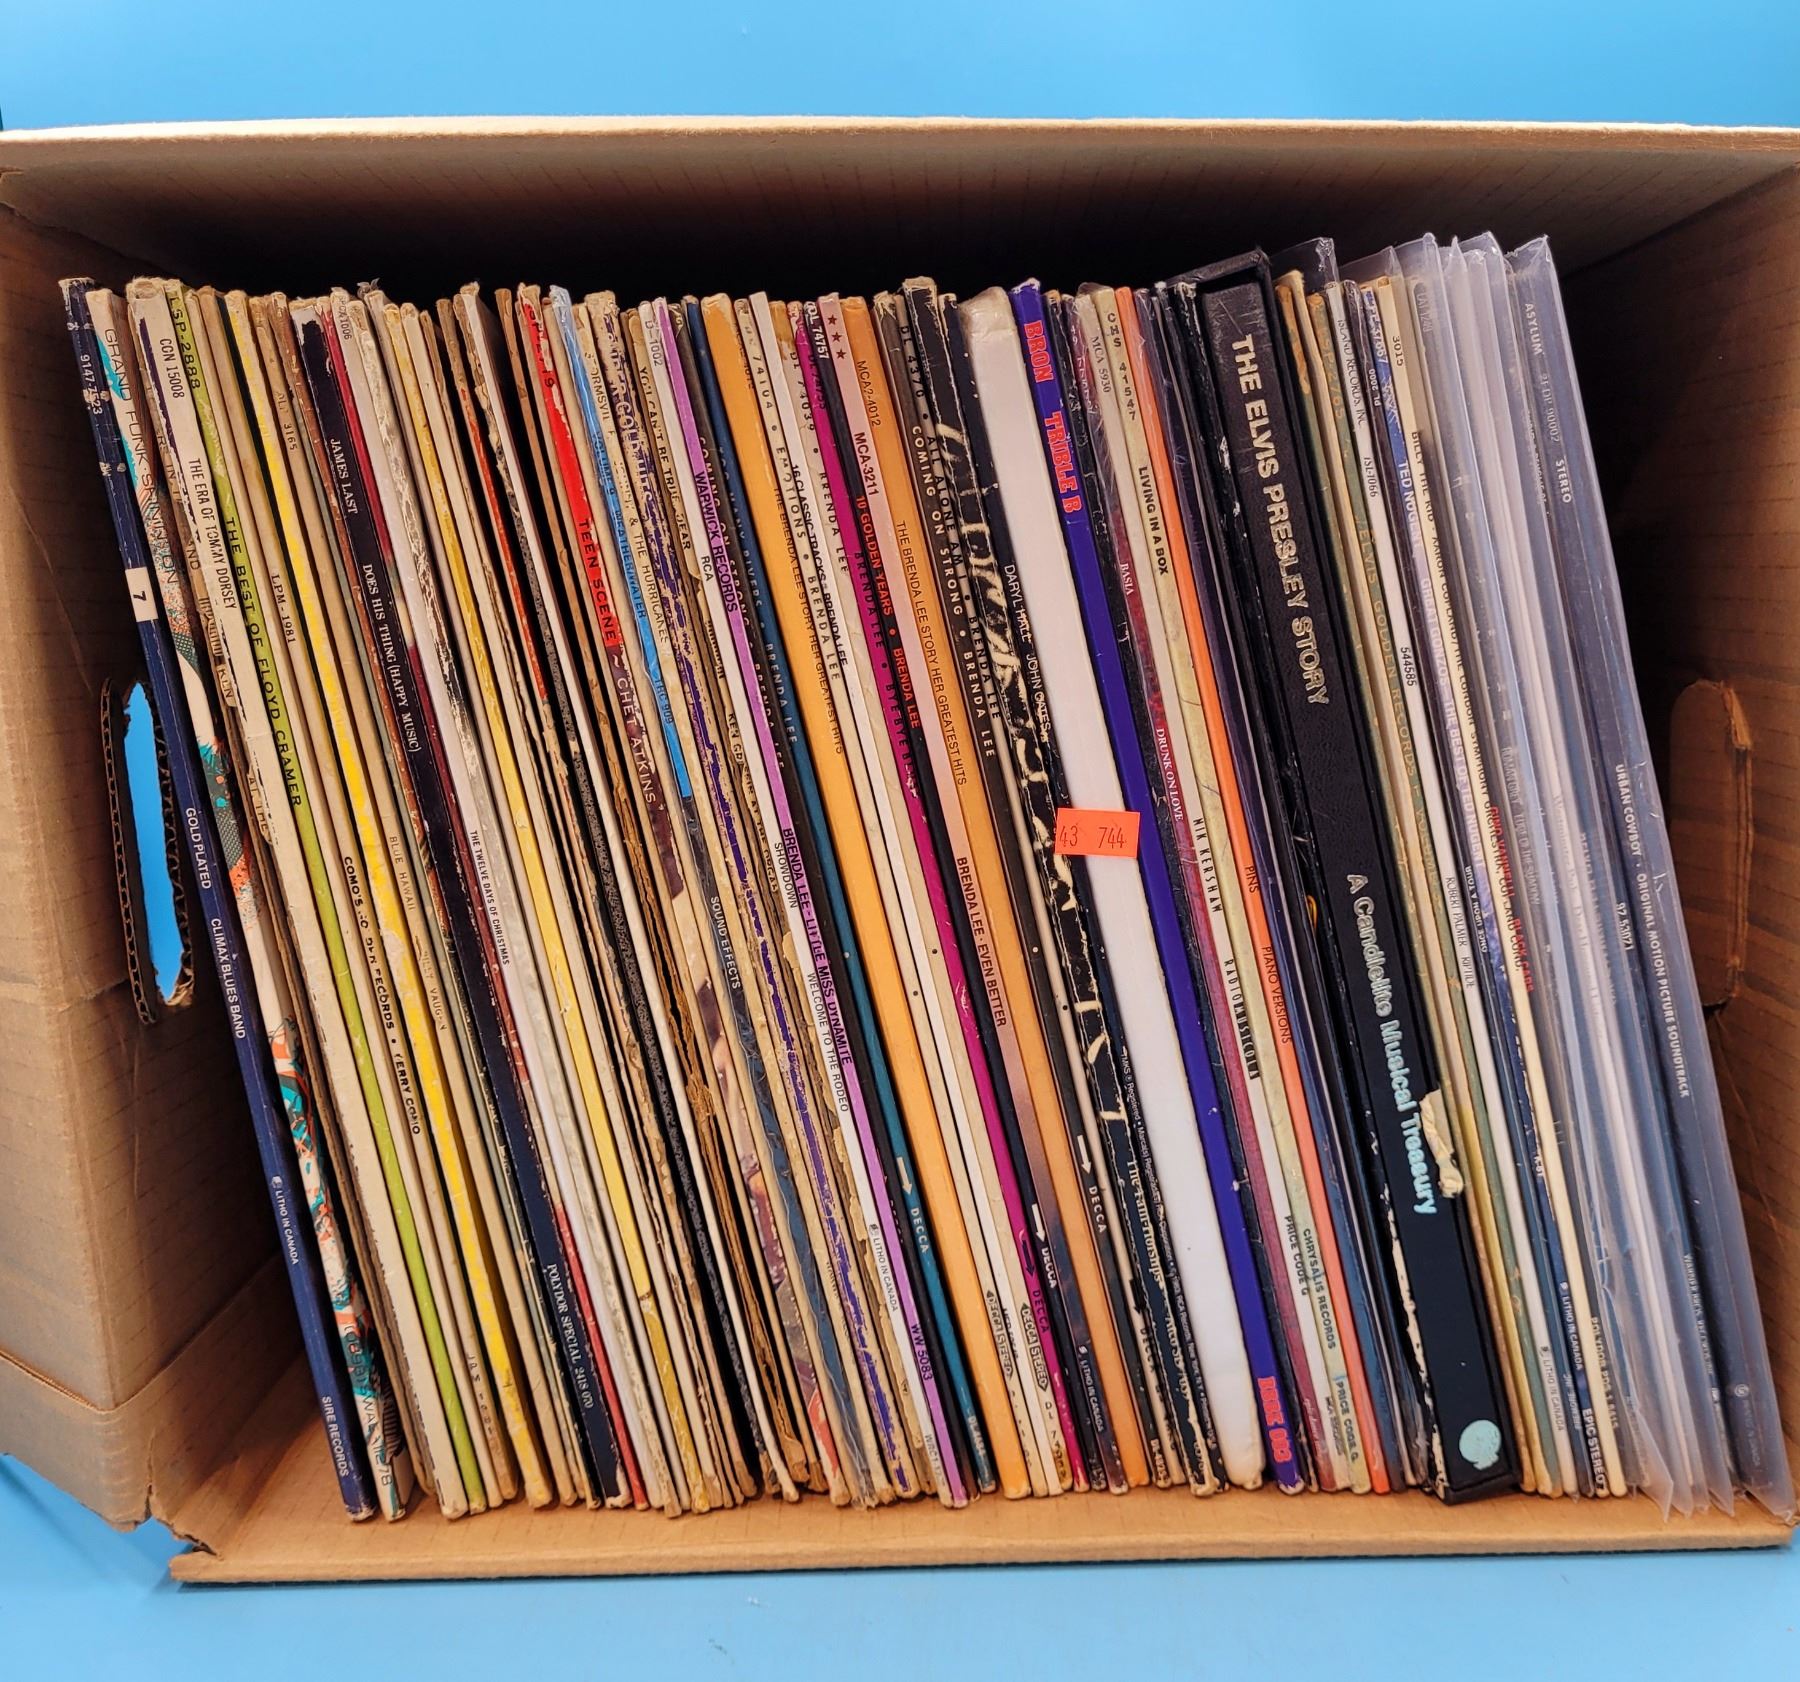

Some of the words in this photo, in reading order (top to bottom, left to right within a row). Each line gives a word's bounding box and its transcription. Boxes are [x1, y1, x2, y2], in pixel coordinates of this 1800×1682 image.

[811, 325, 829, 361] 74757
[1021, 319, 1055, 385] BRON
[1089, 334, 1106, 364] MCA
[1390, 334, 1406, 367] 3015
[164, 365, 185, 399] 15008
[905, 353, 926, 399] 4370
[1097, 366, 1112, 394] 5930
[1228, 332, 1264, 395] THE
[103, 326, 133, 403] GRAND
[123, 409, 149, 466] FUNK
[1522, 301, 1544, 357] ASYLUM
[1553, 457, 1573, 505] STEREO
[924, 433, 942, 466] ALL
[1243, 397, 1282, 479] ELVIS
[187, 457, 204, 482] THE
[328, 436, 350, 480] JAMES
[852, 430, 880, 496] MCA-3211
[1395, 459, 1413, 489] TED
[193, 481, 210, 505] ERA
[340, 481, 359, 515] LAST
[854, 494, 868, 511] 10
[932, 473, 957, 533] ALONE
[1061, 494, 1083, 515] B
[1136, 465, 1157, 514] LIVING
[199, 505, 215, 522] OF
[1147, 515, 1161, 533] IN
[223, 516, 242, 555] THE
[632, 533, 648, 558] THE
[693, 470, 722, 541] WARWICK
[711, 544, 739, 614] RECORDS
[858, 511, 882, 569] GOLDEN
[894, 520, 911, 548] THE
[948, 539, 966, 567] AM
[1260, 481, 1310, 612] PRESLEY
[360, 562, 380, 595] DOES
[576, 519, 600, 569] TEEN
[590, 576, 618, 642] SCENE
[699, 554, 715, 582] RCA
[900, 546, 923, 600] BRENDA
[1118, 561, 1135, 596] BASIA
[1153, 547, 1170, 576] BOX
[214, 566, 237, 611] DORSEY
[234, 564, 255, 613] BEST
[873, 571, 894, 617] YEARS
[909, 424, 937, 498] COMING
[929, 509, 945, 535] ON
[937, 546, 964, 616] STRONG
[961, 650, 987, 719] BRENDA
[979, 729, 996, 758] LEE
[1002, 563, 1024, 607] DARYL
[369, 596, 387, 621] HIS
[913, 598, 929, 624] LEE
[247, 621, 264, 649] OF
[376, 622, 398, 664] THING
[919, 624, 940, 667] STORY
[967, 615, 993, 684] BRENDA
[1356, 527, 1379, 585] ELVIS
[1372, 599, 1399, 679] GOLDEN
[1389, 686, 1419, 777] RECORDS
[891, 646, 915, 702] BRENDA
[929, 666, 946, 693] HER
[1024, 651, 1044, 690] JOHN
[1289, 613, 1331, 709] STORY
[1397, 645, 1417, 688] 544585
[255, 657, 282, 721] FLOYD
[386, 663, 410, 708] (HAPPY
[985, 690, 1002, 720] LEE
[399, 711, 422, 754] MUSIC)
[905, 703, 921, 729] LEE
[935, 692, 961, 757] GREATEST
[614, 677, 637, 726] CHET
[629, 734, 657, 805] ATKINS
[1153, 726, 1173, 771] DRUNK
[273, 729, 303, 807] CRAMER
[951, 757, 968, 786] HITS
[1163, 770, 1177, 790] ON
[1613, 762, 1632, 805] URBAN
[183, 806, 203, 843] GOLD
[1167, 789, 1185, 822] LOVE
[469, 829, 481, 847] THE
[1060, 825, 1078, 848] 43
[1098, 826, 1126, 849] 744
[1190, 817, 1207, 842] NIK
[1621, 805, 1643, 859] COWBOY
[192, 843, 213, 889] PLATED
[473, 848, 490, 881] TWELVE
[780, 827, 804, 881] BRENDA
[481, 882, 495, 904] DAYS
[772, 841, 798, 909] SHOWDOWN
[955, 855, 979, 911] BRENDA
[1198, 847, 1224, 914] KERSHAW
[1242, 864, 1259, 894] PINS
[1345, 870, 1370, 894] A
[1444, 875, 1462, 910] ROBERT
[1463, 864, 1477, 892] TOUR
[488, 905, 499, 917] OF
[795, 883, 811, 910] LEE
[1470, 901, 1484, 928] UPON
[1634, 871, 1657, 930] ORIGINAL
[209, 917, 230, 963] CLIMAX
[490, 917, 511, 965] CHRISTMAS
[708, 895, 728, 937] SOUND
[718, 938, 742, 990] EFFECTS
[969, 911, 985, 937] LEE
[1451, 910, 1470, 947] PALMER
[1476, 928, 1489, 954] ONCE
[976, 942, 995, 978] EVEN
[1260, 944, 1279, 985] PIANO
[1645, 928, 1666, 978] MOTION
[219, 962, 239, 1003] BLUES
[805, 971, 829, 1028] WELCOME
[816, 964, 835, 999] MISS
[1222, 958, 1243, 1003] RADIO
[984, 978, 1008, 1028] BETTER
[1269, 986, 1293, 1045] VERSIONS
[1655, 977, 1675, 1024] PICTURE
[228, 1003, 247, 1039] BAND
[819, 1028, 834, 1047] TO
[825, 999, 853, 1066] DYNAMITE
[824, 1047, 840, 1071] THE
[1377, 1018, 1418, 1113] Musical
[1664, 1023, 1691, 1099] SOUNDTRACK
[830, 1071, 851, 1113] RODEO
[1392, 1110, 1441, 1219] Treasury
[274, 1189, 288, 1217] LITHO
[280, 1217, 291, 1228] IN
[1086, 1184, 1107, 1234] DECCA
[283, 1228, 299, 1265] CANADA
[871, 1236, 885, 1262] LITHO
[908, 1206, 930, 1253] DECCA
[878, 1263, 889, 1275] IN
[1039, 1246, 1058, 1289] DECCA
[881, 1275, 898, 1312] CANADA
[1300, 1227, 1324, 1294] CHRYSALIS
[1315, 1294, 1337, 1350] RECORDS
[545, 1262, 570, 1313] POLYDOR
[559, 1314, 583, 1364] SPECIAL
[1030, 1288, 1050, 1334] DECCA
[1560, 1295, 1574, 1322] LITHO
[1565, 1321, 1576, 1334] IN
[909, 1322, 925, 1348] WW
[1020, 1307, 1038, 1344] DECCA
[1029, 1345, 1049, 1387] STEREO
[1568, 1332, 1584, 1371] CANADA
[915, 1348, 933, 1381] 5083
[1079, 1359, 1093, 1386] LITHO
[320, 1395, 336, 1423] SIRE
[1085, 1385, 1096, 1397] IN
[1334, 1380, 1351, 1416] PRICE
[1088, 1395, 1105, 1433] CANADA
[1549, 1395, 1565, 1433] CANADA
[1580, 1406, 1598, 1438] EPIC
[327, 1422, 349, 1477] RECORDS
[1586, 1435, 1607, 1486] STEREO
